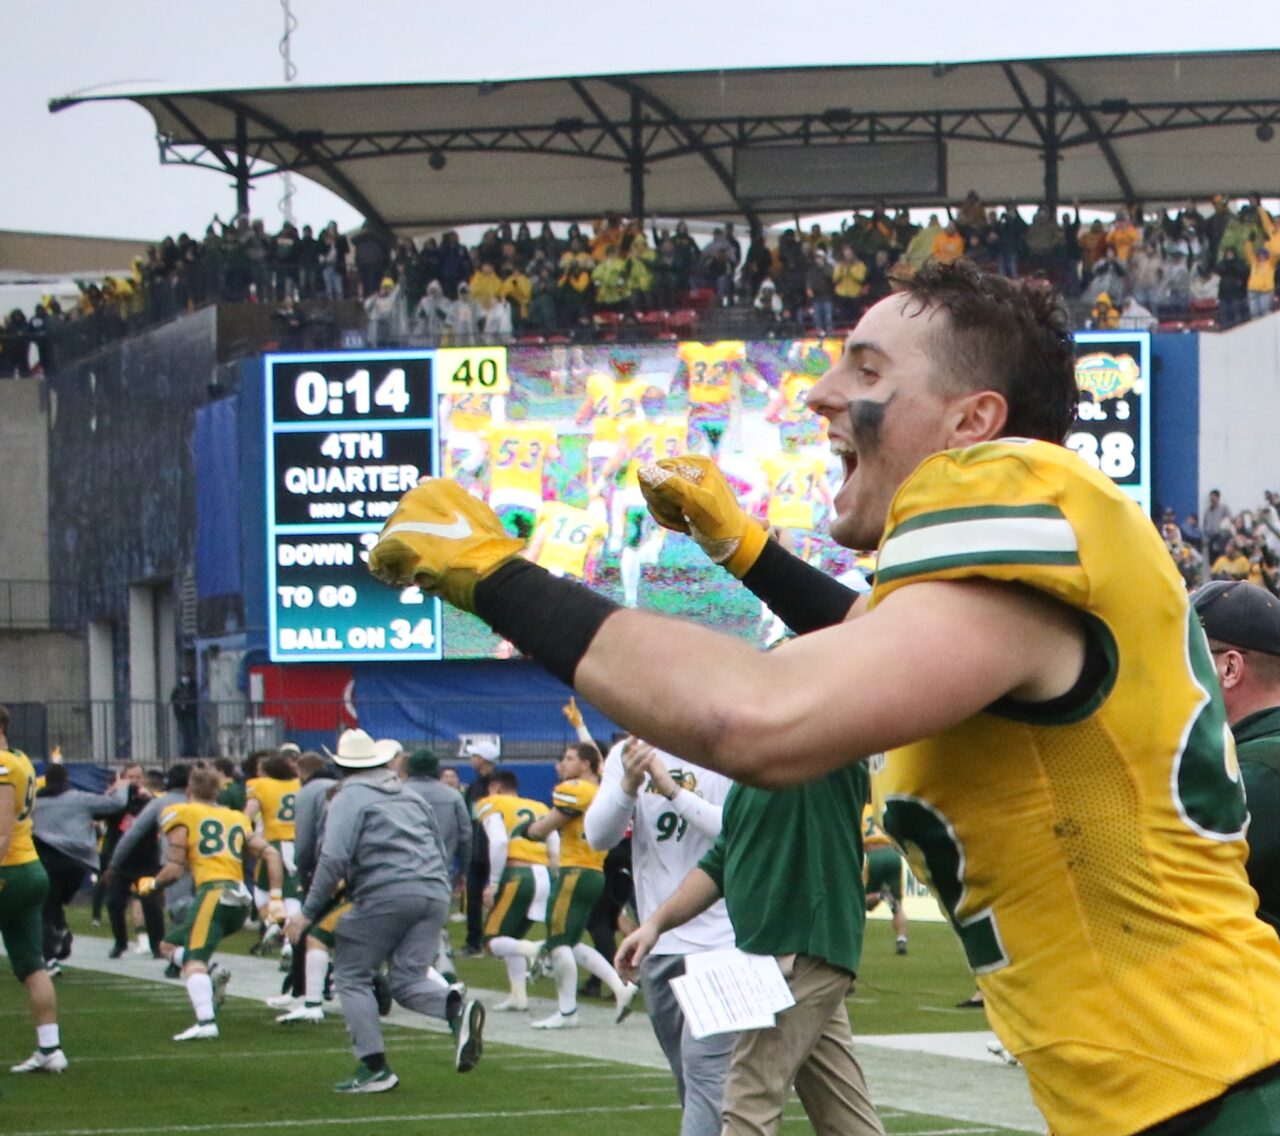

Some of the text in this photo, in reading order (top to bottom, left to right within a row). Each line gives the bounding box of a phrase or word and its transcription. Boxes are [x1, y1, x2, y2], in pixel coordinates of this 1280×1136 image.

[452, 358, 498, 387] 40
[294, 368, 411, 416] 0:14
[1073, 401, 1108, 420] OL
[320, 431, 384, 460] 4TH
[496, 438, 543, 469] 53
[284, 463, 420, 495] QUARTER
[552, 516, 592, 546] 16
[277, 542, 354, 567] DOWN
[277, 585, 314, 609] TO
[318, 584, 358, 608] GO
[278, 617, 436, 651] BALL ON 34
[197, 819, 246, 860] 80
